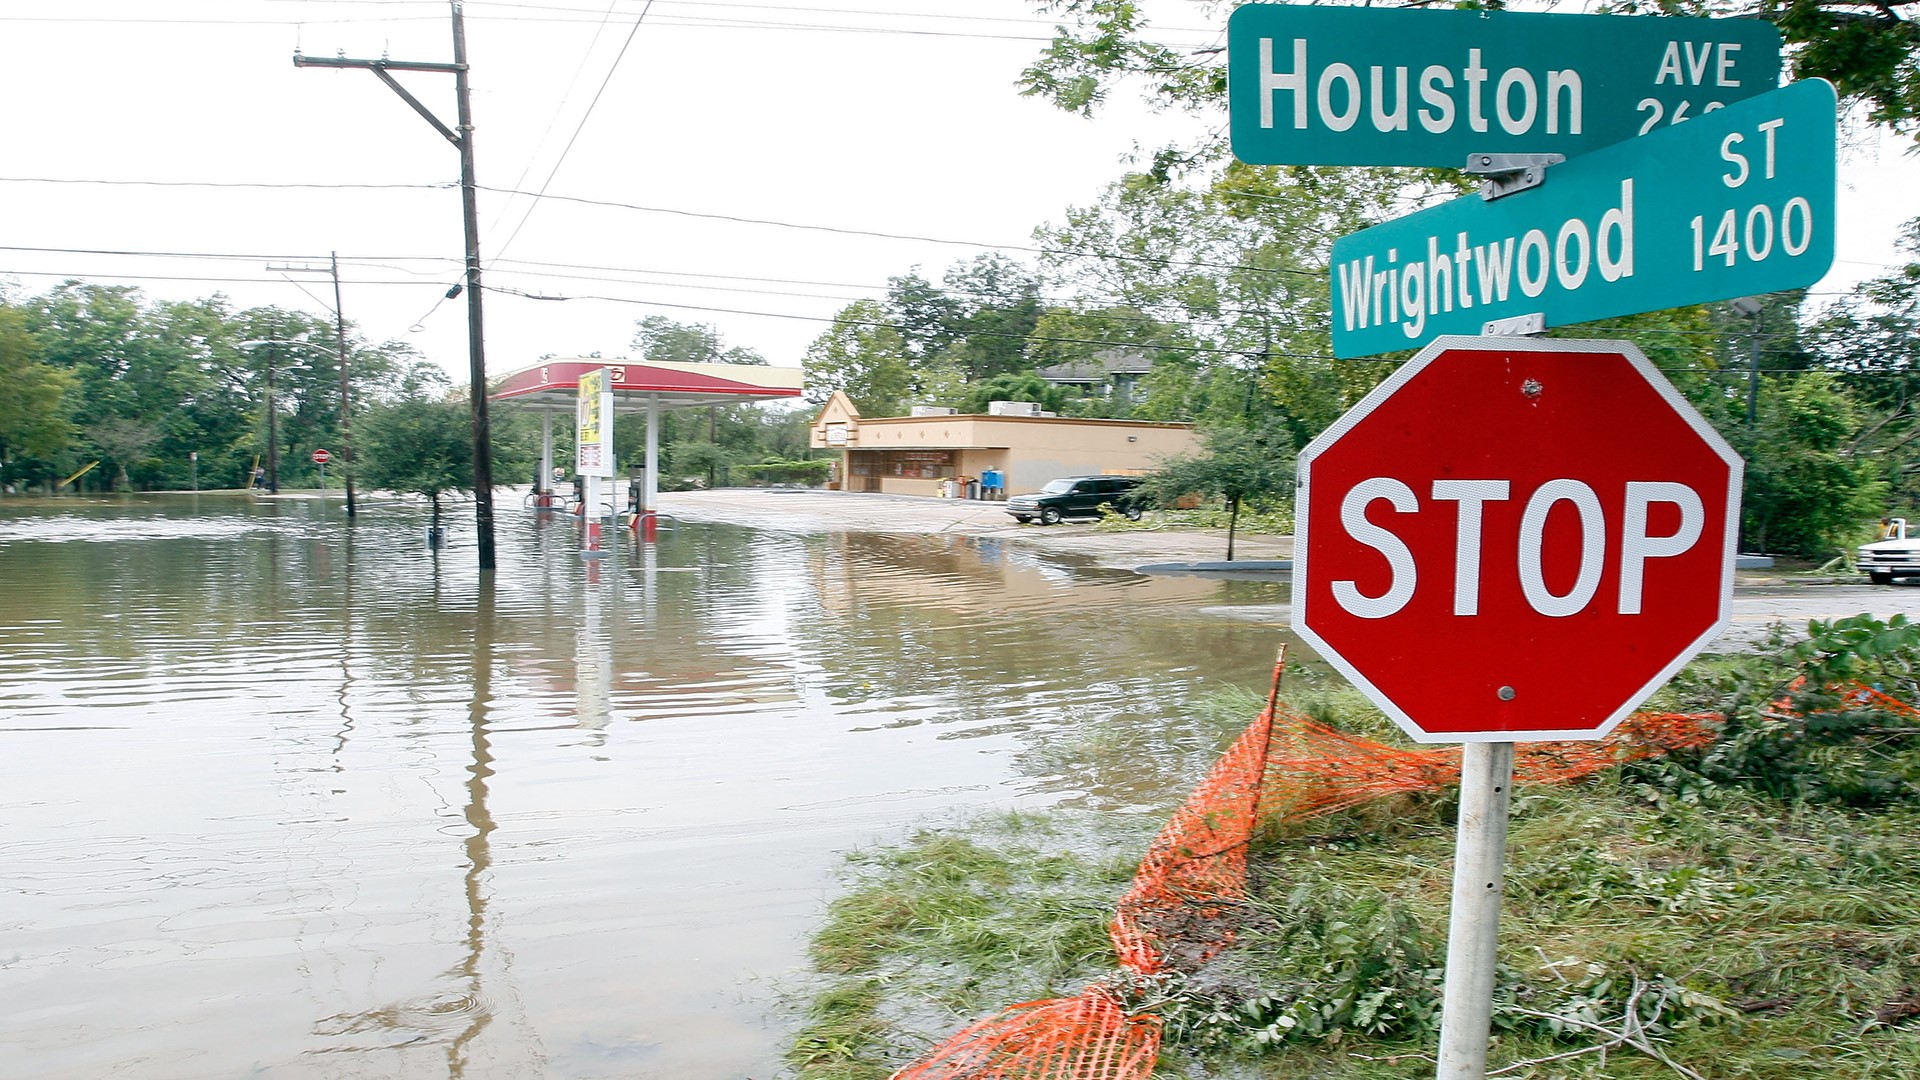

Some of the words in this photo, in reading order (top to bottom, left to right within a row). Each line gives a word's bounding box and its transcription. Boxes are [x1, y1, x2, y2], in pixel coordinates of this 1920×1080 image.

[1260, 37, 1582, 135] Houston
[1655, 41, 1741, 87] AVE
[1339, 178, 1634, 339] Wrightwood
[1721, 118, 1784, 188] ST
[1691, 197, 1812, 272] 1400
[1331, 477, 1705, 618] STOP
